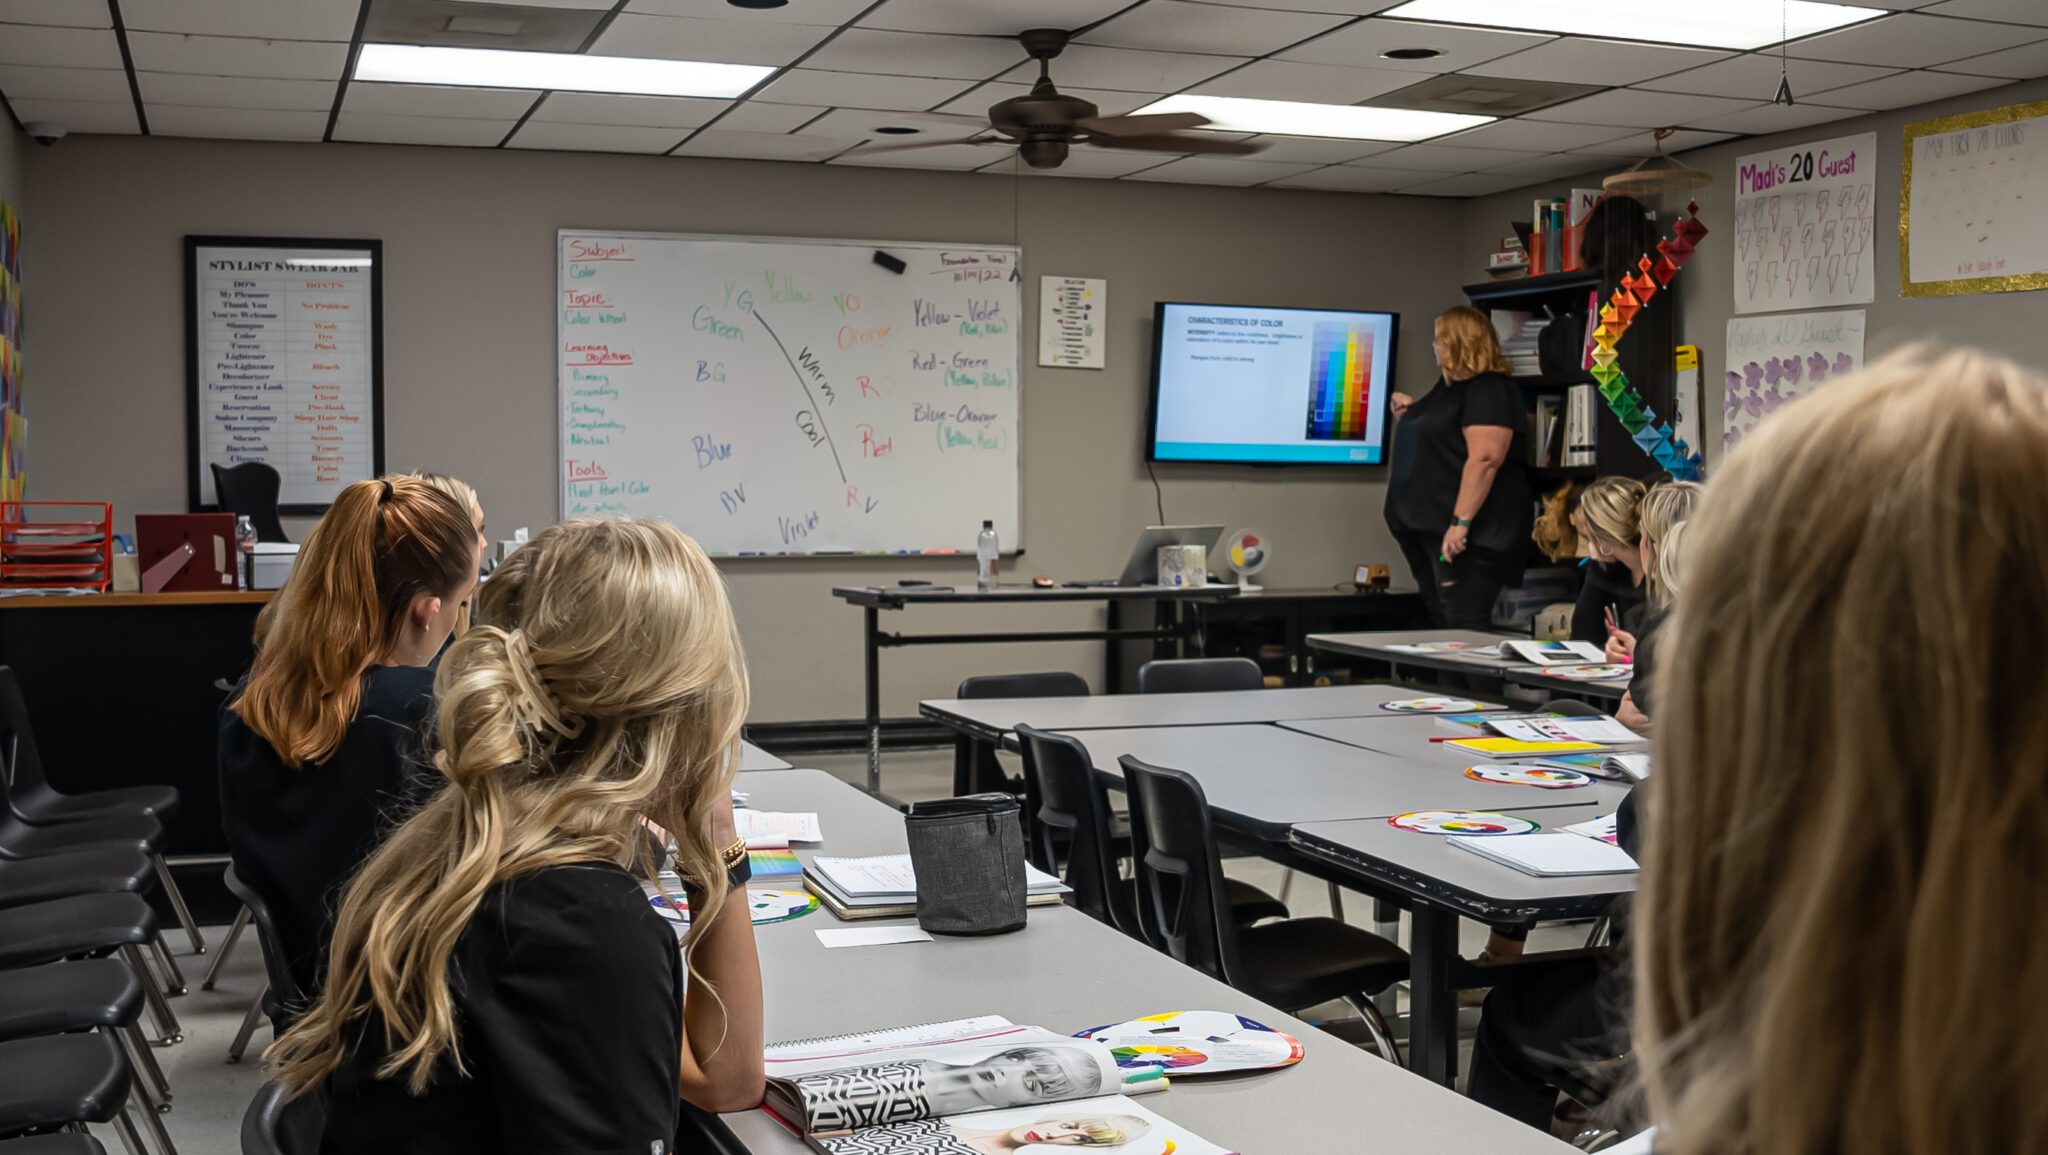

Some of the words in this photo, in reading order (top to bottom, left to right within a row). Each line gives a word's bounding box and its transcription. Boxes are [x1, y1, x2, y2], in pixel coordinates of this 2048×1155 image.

[1740, 160, 1786, 195] Madi's
[1789, 151, 1814, 183] 20
[1818, 149, 1856, 178] Guest
[570, 240, 626, 259] Subject
[209, 261, 272, 271] STYLIST
[569, 264, 597, 278] Color
[765, 269, 813, 304] Yellow
[252, 301, 268, 309] You
[564, 289, 606, 306] Topic
[226, 322, 264, 330] Shampoo
[692, 304, 745, 343] Green
[1188, 316, 1248, 326] CHARACTERISTICS
[1250, 319, 1258, 327] OF
[1260, 319, 1283, 328] COLOR
[234, 332, 256, 340] Color
[836, 324, 892, 350] Orange
[565, 342, 609, 354] Learning
[225, 353, 266, 361] Lightener
[208, 383, 254, 391] Experience
[263, 383, 284, 391] Look
[241, 414, 278, 423] Company
[795, 409, 826, 449] Cool
[856, 423, 892, 459] Red
[691, 433, 732, 471] Blue
[566, 460, 606, 478] Tools
[777, 510, 820, 545] Violet
